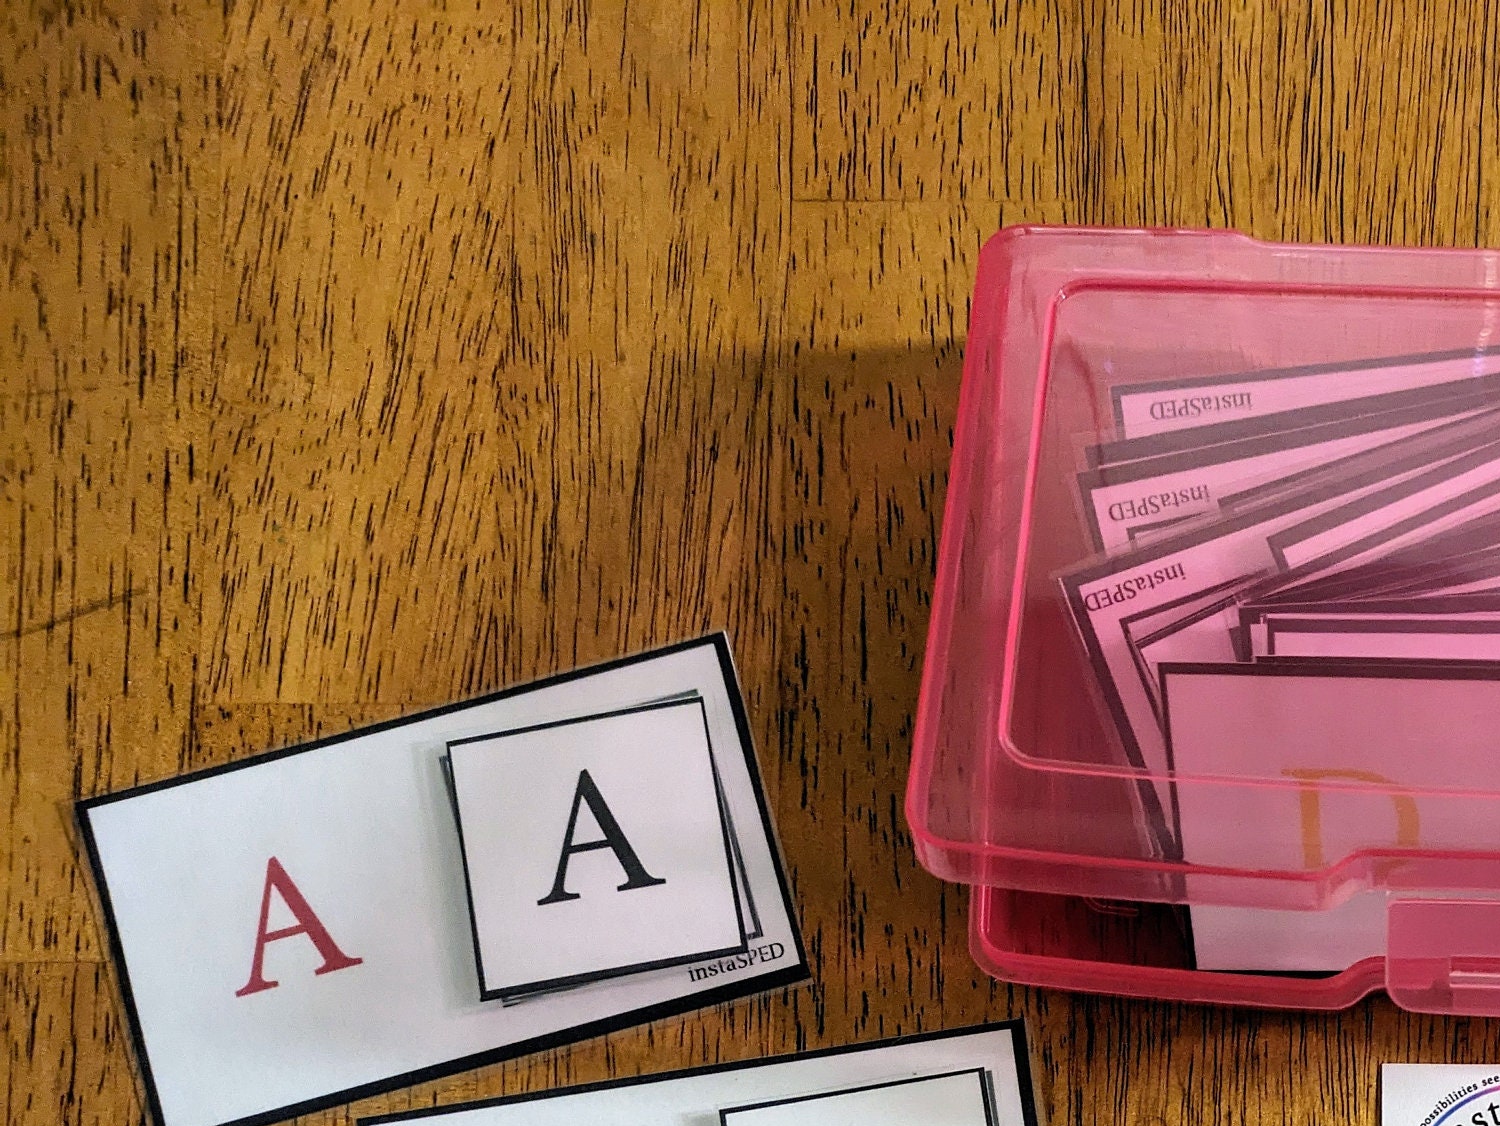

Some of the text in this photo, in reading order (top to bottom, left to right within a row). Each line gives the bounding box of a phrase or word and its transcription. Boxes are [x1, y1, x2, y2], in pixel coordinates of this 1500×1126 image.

[1150, 392, 1253, 420] instaSPED
[1108, 484, 1210, 522] instaSPED
[1084, 562, 1187, 612] instaSPED
[537, 769, 666, 905] A
[1281, 768, 1420, 888] D
[237, 858, 362, 996] A
[688, 942, 785, 983] instaSPED
[1482, 1076, 1499, 1086] see
